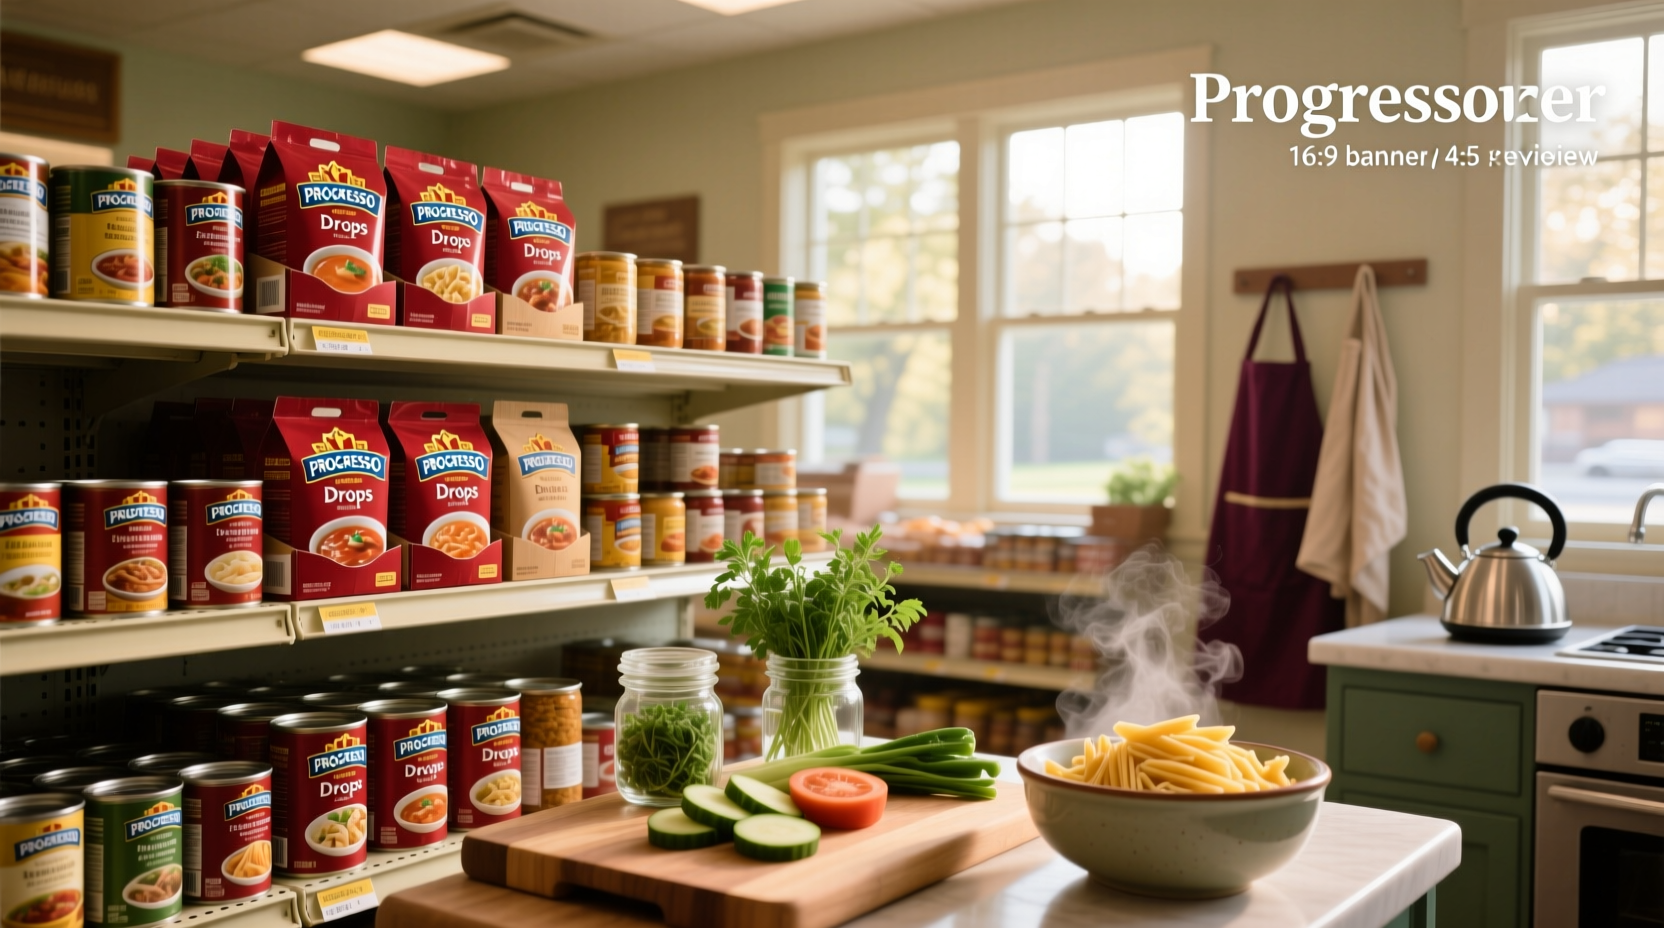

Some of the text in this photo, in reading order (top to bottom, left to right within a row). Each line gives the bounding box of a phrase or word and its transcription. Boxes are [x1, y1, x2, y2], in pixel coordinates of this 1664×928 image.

[320, 213, 369, 240] Drops
[324, 486, 374, 510] Drops
[436, 483, 479, 506] Drops
